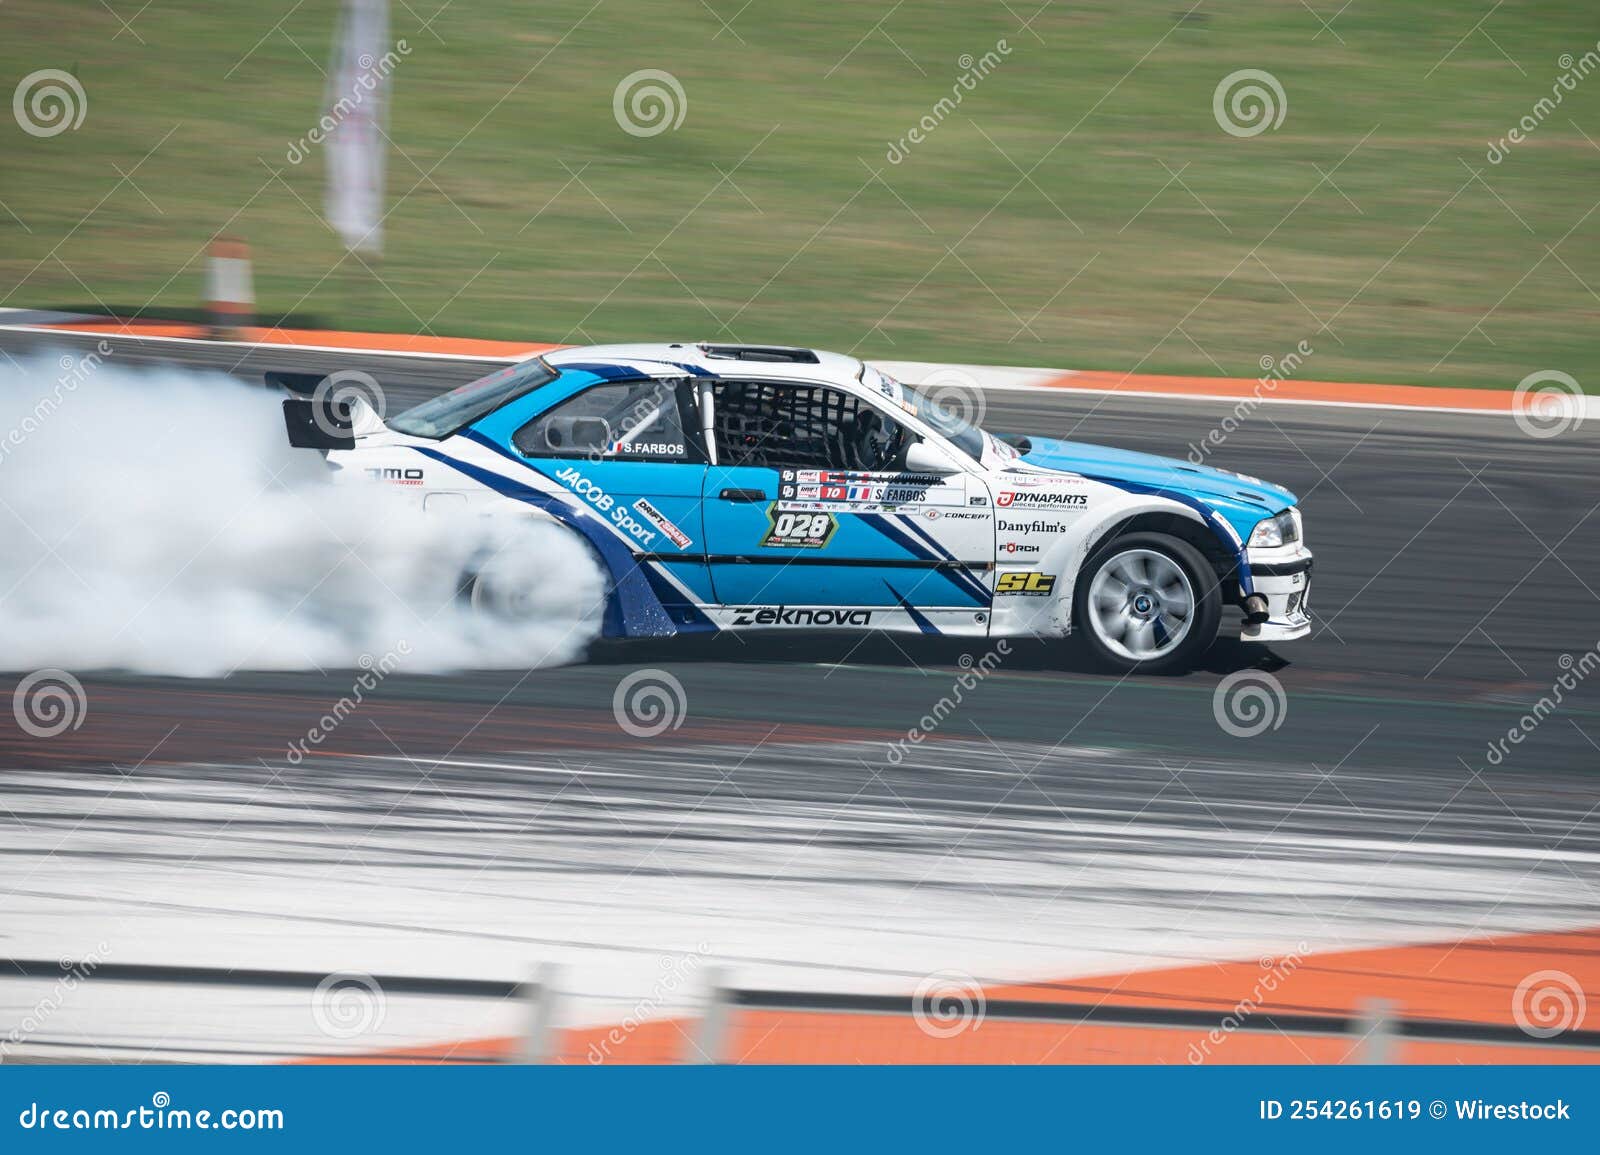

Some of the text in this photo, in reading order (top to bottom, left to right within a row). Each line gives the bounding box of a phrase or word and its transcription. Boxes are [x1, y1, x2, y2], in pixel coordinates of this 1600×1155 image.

[624, 443, 684, 454] S.FARBOS
[826, 488, 840, 498] 10
[887, 489, 926, 502] FARBOS
[1014, 492, 1087, 504] DYNAPARTS
[556, 467, 656, 545] JACOB Sport
[944, 512, 991, 520] CONCEPT
[774, 514, 830, 537] 028
[998, 520, 1066, 535] Danyfilm's
